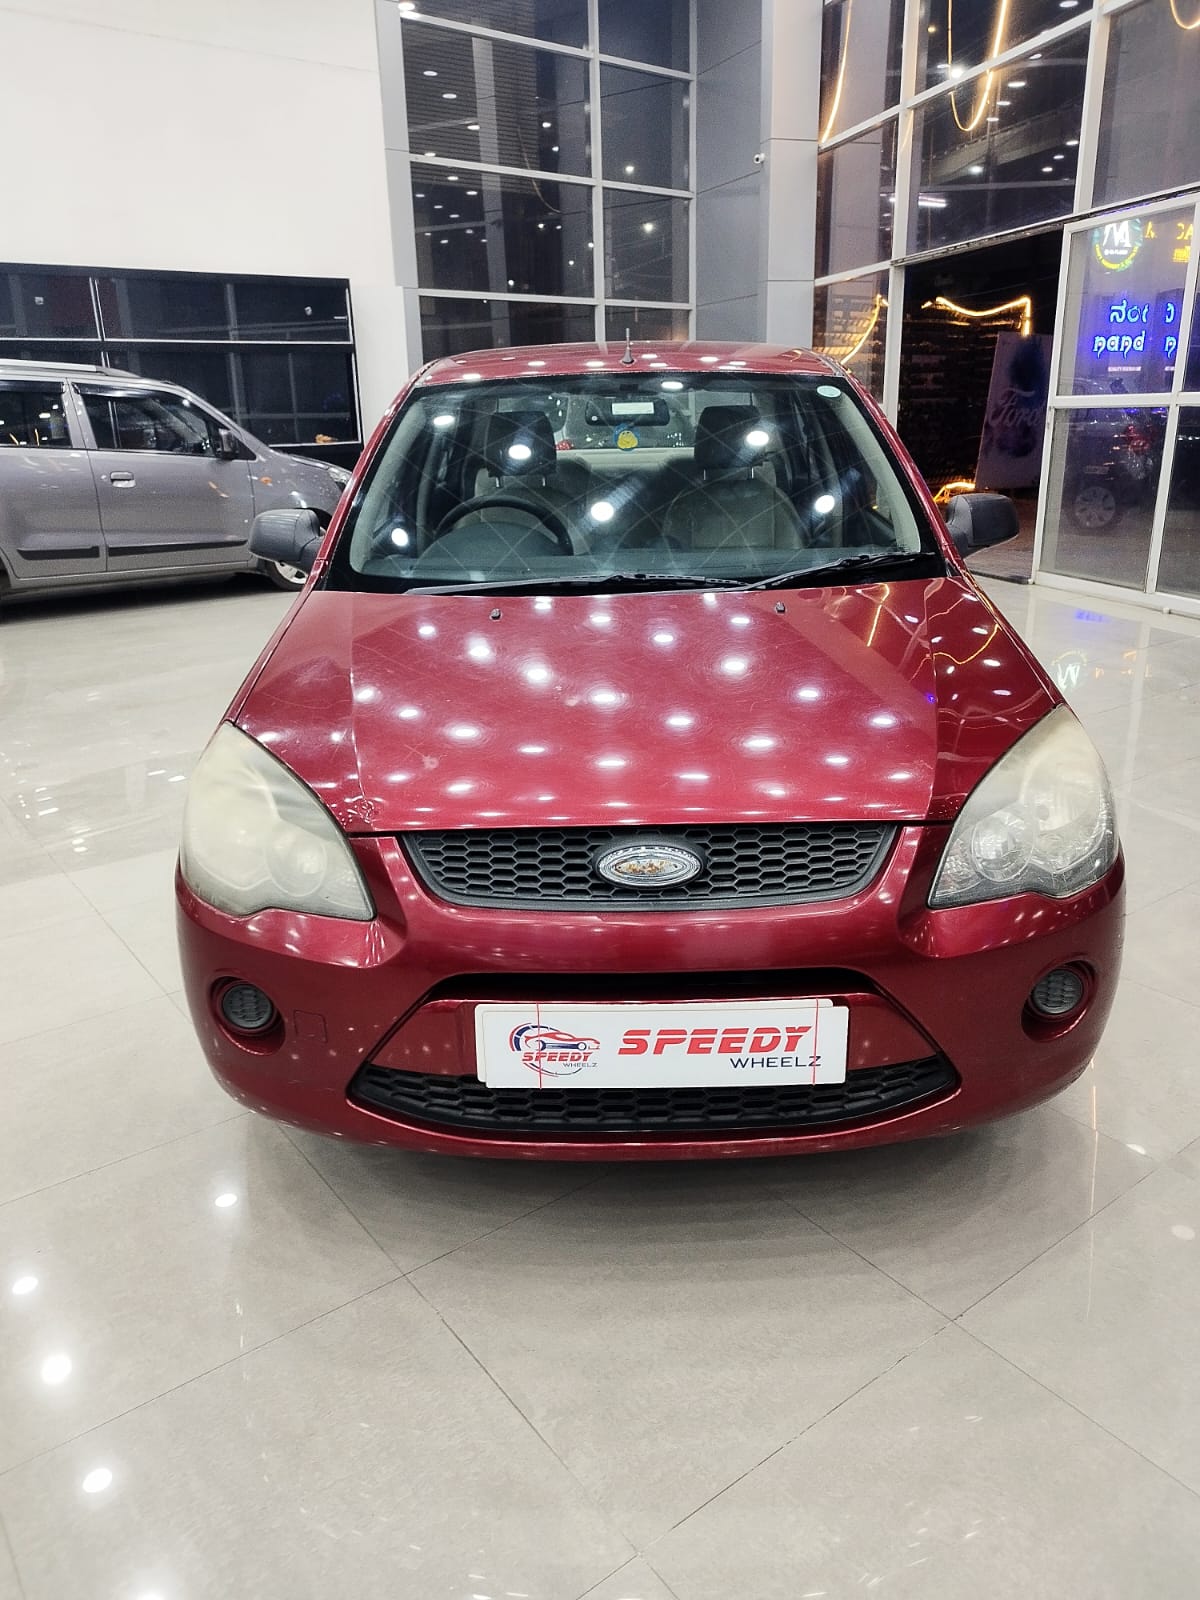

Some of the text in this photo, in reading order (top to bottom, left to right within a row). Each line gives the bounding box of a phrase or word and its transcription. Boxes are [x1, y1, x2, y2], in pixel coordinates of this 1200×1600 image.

[617, 1026, 813, 1056] SPEEDY
[521, 1051, 594, 1063] SPEEDY
[729, 1055, 822, 1069] WHEELZ
